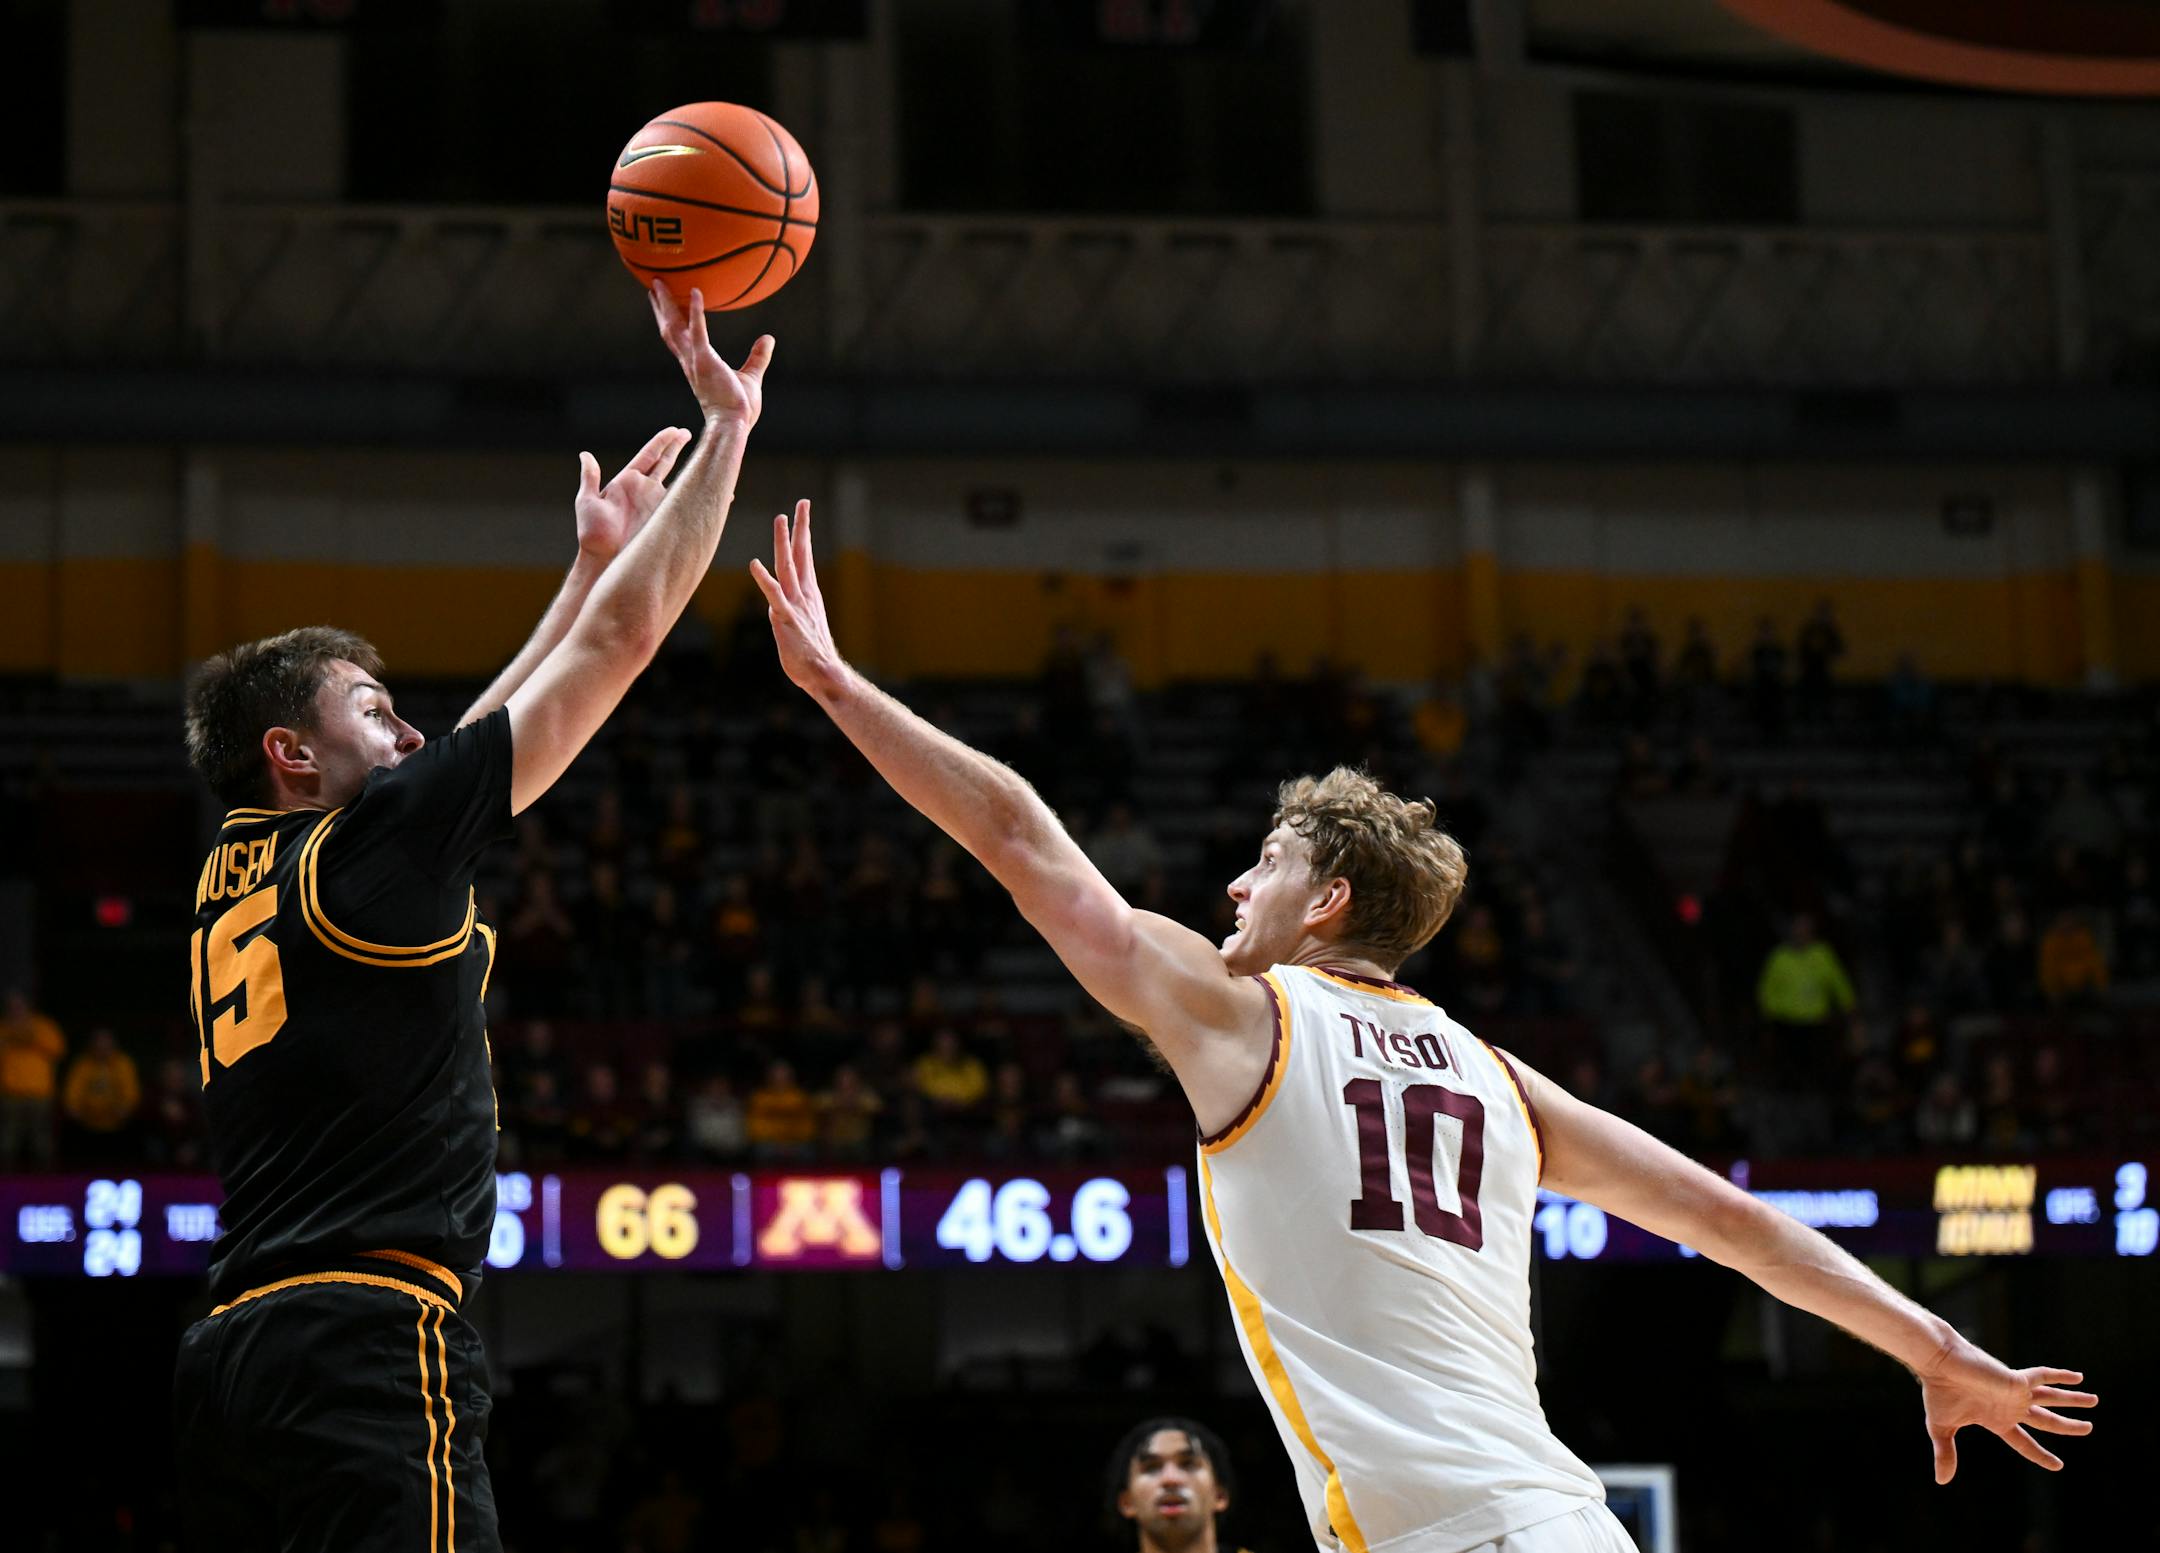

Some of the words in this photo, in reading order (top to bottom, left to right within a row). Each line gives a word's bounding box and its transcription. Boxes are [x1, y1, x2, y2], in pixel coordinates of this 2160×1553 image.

[609, 206, 683, 244] ELITE
[190, 883, 288, 1092] 15
[84, 1179, 142, 1228] 24
[1343, 1077, 1485, 1253] 10
[84, 1229, 142, 1277] 24
[596, 1183, 699, 1260] 66
[758, 1178, 880, 1257] M
[936, 1178, 1133, 1262] 46.6
[1533, 1202, 1607, 1260] 10
